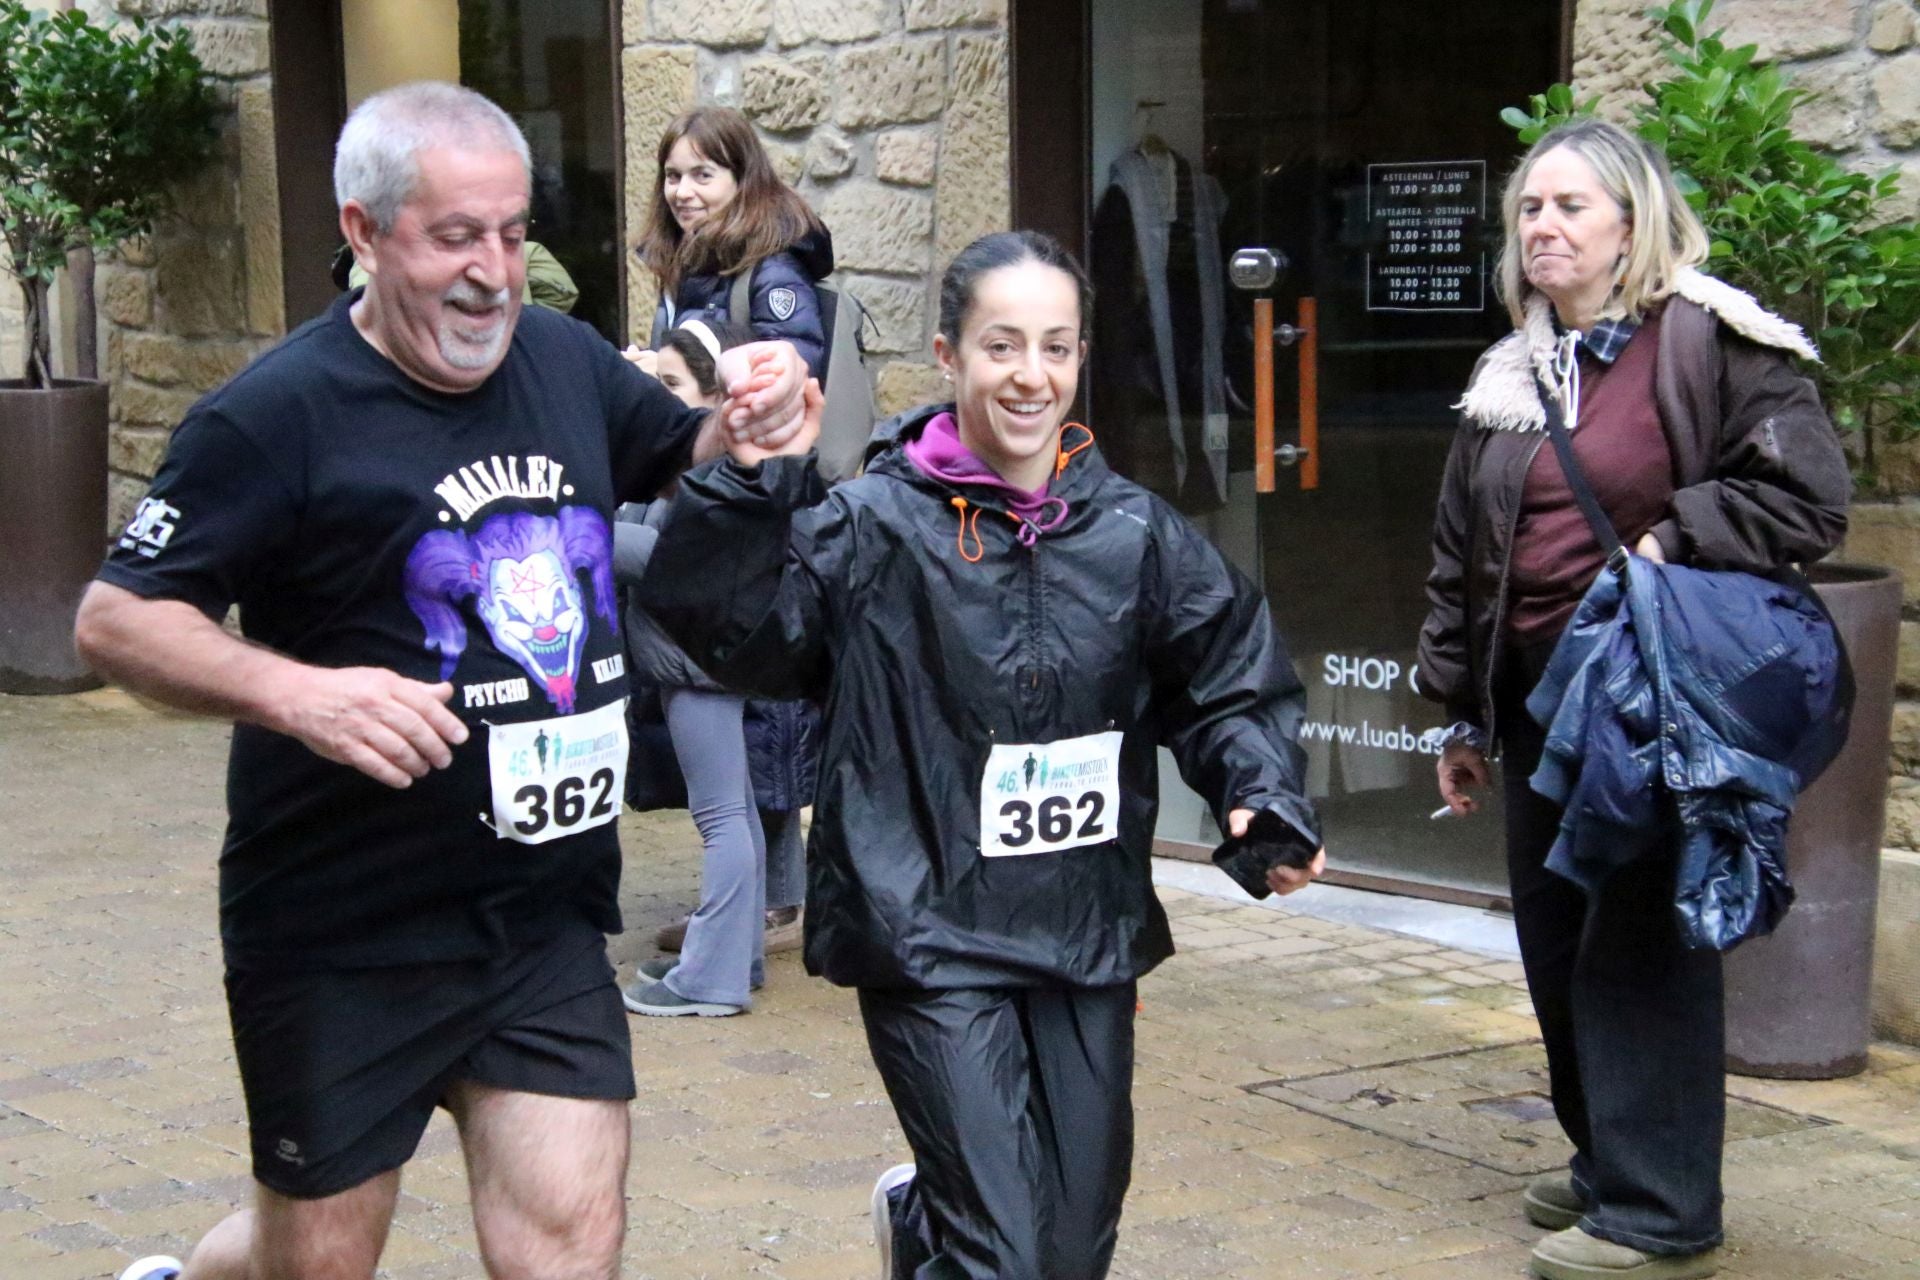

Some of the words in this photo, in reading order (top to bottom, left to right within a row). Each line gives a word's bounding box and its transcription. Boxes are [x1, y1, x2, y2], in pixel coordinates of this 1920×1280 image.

[1383, 172, 1434, 181] ASTELEHENA
[1444, 171, 1470, 180] LUNES
[1390, 184, 1418, 194] 17.00
[1431, 183, 1462, 194] 20.00
[1375, 207, 1422, 217] ASTEARTEA
[1388, 218, 1420, 226] MARTES
[1390, 230, 1419, 240] 10.00
[1432, 230, 1461, 239] 13.00
[1390, 243, 1417, 253] 17.00
[1430, 243, 1461, 253] 20.00
[1379, 266, 1427, 274] LARUNBATA
[1437, 266, 1472, 274] SABADO
[1390, 278, 1419, 287] 10.00
[1432, 278, 1460, 287] 13.30
[1390, 291, 1417, 301] 17.00
[1430, 291, 1460, 301] 20.00
[1323, 653, 1400, 691] SHOP
[463, 677, 530, 708] PSYCHO
[996, 770, 1019, 793] 46.
[513, 767, 614, 836] 362
[999, 791, 1105, 848] 362
